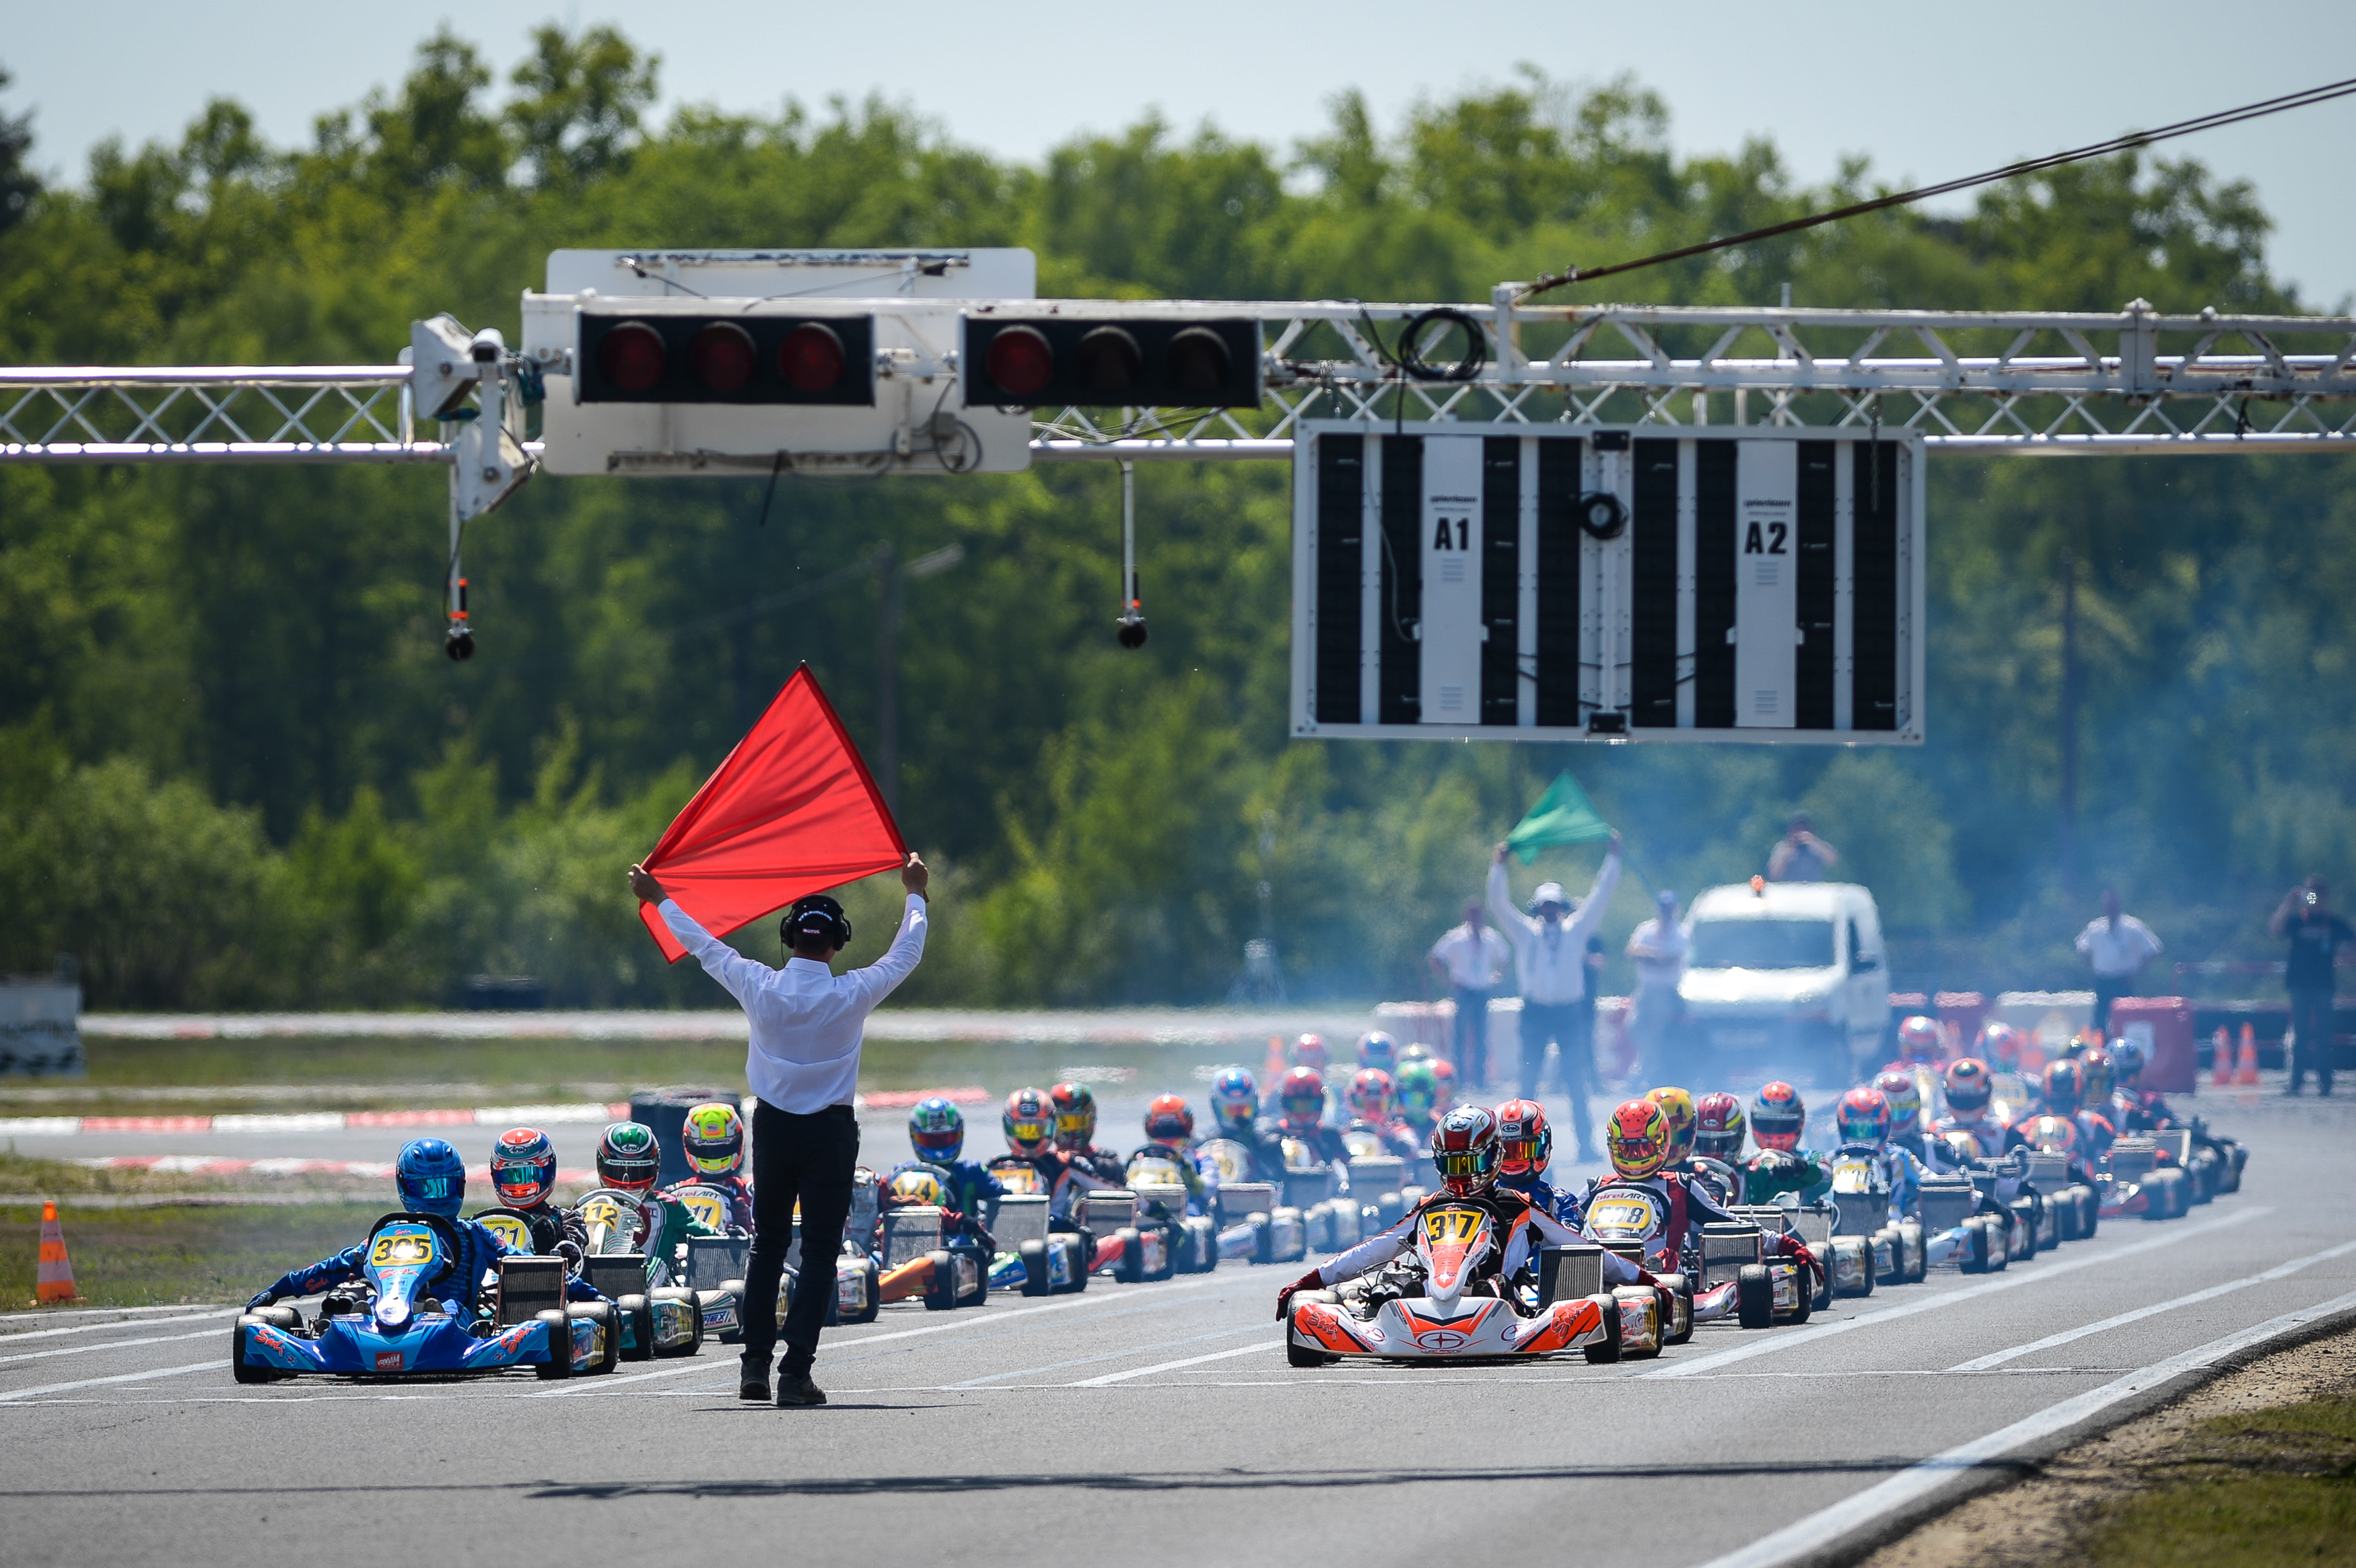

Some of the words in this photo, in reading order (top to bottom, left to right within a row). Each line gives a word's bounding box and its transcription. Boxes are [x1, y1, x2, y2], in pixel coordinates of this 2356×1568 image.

[1433, 518, 1469, 550] A1
[1744, 522, 1788, 555] A2
[675, 1190, 720, 1199] irelART
[1430, 1213, 1476, 1242] 317
[254, 1329, 285, 1357] Sodi
